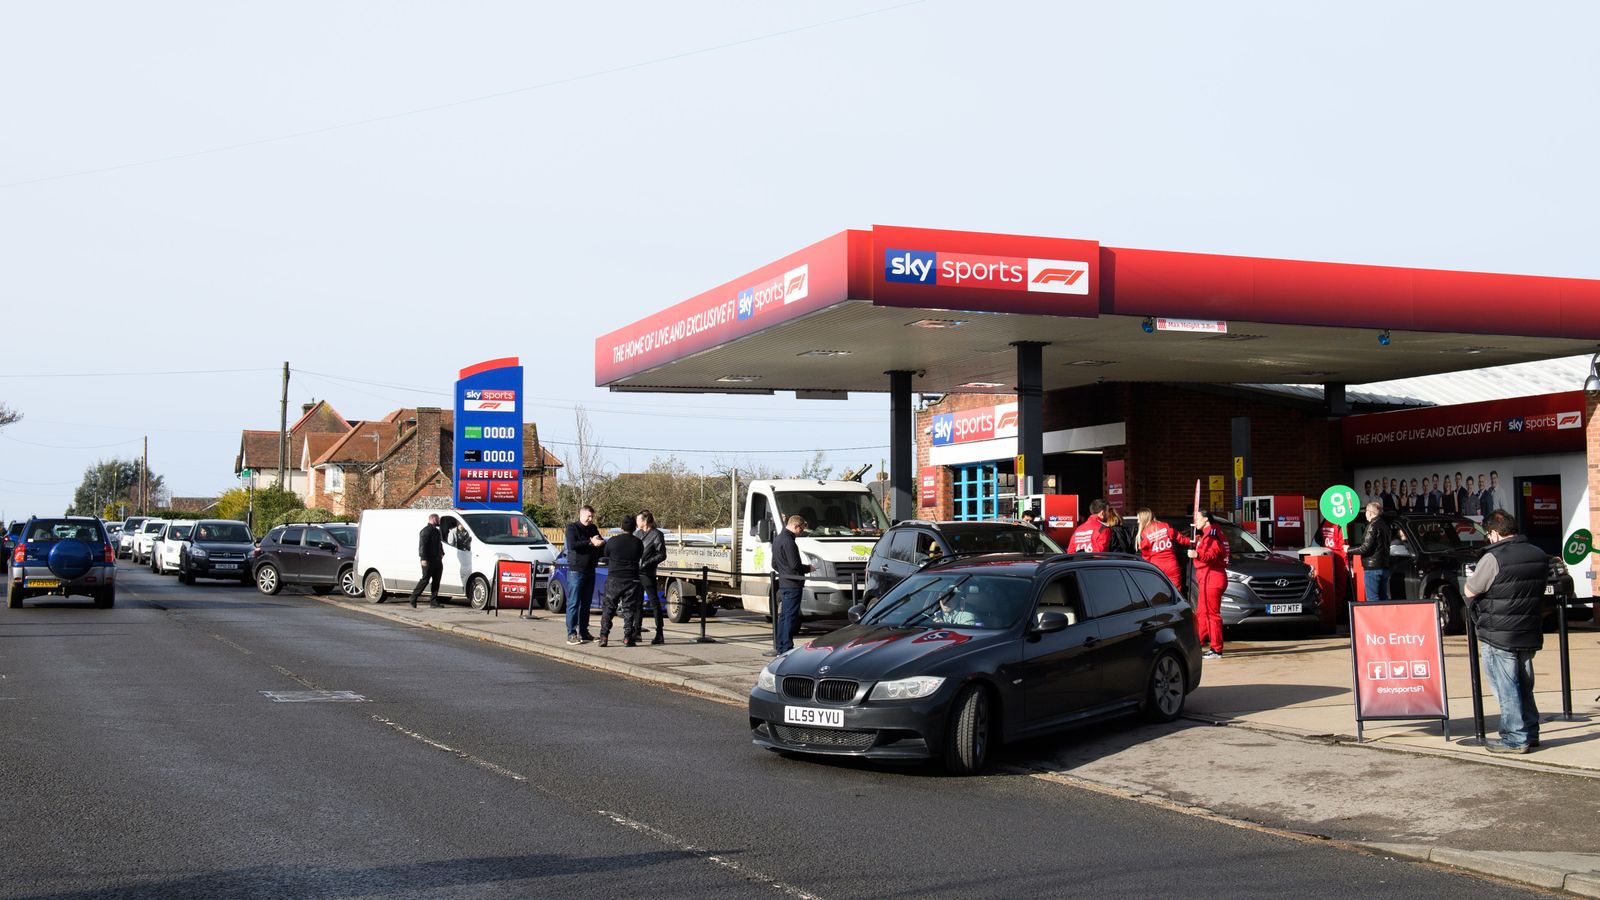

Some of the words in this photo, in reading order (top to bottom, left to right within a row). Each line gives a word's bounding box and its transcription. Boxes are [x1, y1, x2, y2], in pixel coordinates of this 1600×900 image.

[891, 252, 932, 282] sky
[942, 260, 1023, 284] sports
[613, 344, 625, 364] THE
[625, 336, 644, 360] HOME
[645, 332, 654, 352] OF
[654, 326, 670, 348] LIVE
[669, 320, 685, 343] AND
[686, 304, 727, 336] EXCLUSIVE
[727, 299, 736, 322] F1
[739, 293, 752, 316] sky
[755, 282, 783, 311] sports
[466, 390, 481, 399] sky
[484, 392, 513, 400] sports
[483, 426, 514, 439] 000.0
[935, 417, 952, 441] sky
[956, 412, 992, 439] sports
[1356, 434, 1370, 445] THE
[1371, 432, 1394, 444] HOME
[1396, 430, 1407, 441] OF
[1408, 429, 1425, 440] LIVE
[1426, 427, 1444, 438] AND
[1446, 422, 1492, 436] EXCLUSIVE
[1493, 421, 1502, 432] F1
[1508, 419, 1523, 432] sky
[1525, 416, 1556, 430] sports
[483, 450, 514, 462] 000.0
[467, 470, 488, 478] FREE
[1331, 492, 1346, 518] GO
[1152, 538, 1172, 552] 406
[1367, 634, 1385, 645] No
[1389, 633, 1425, 646] Entry
[1377, 686, 1424, 694] @skysportsF1
[789, 709, 814, 722] LL59
[818, 711, 839, 724] YVU
